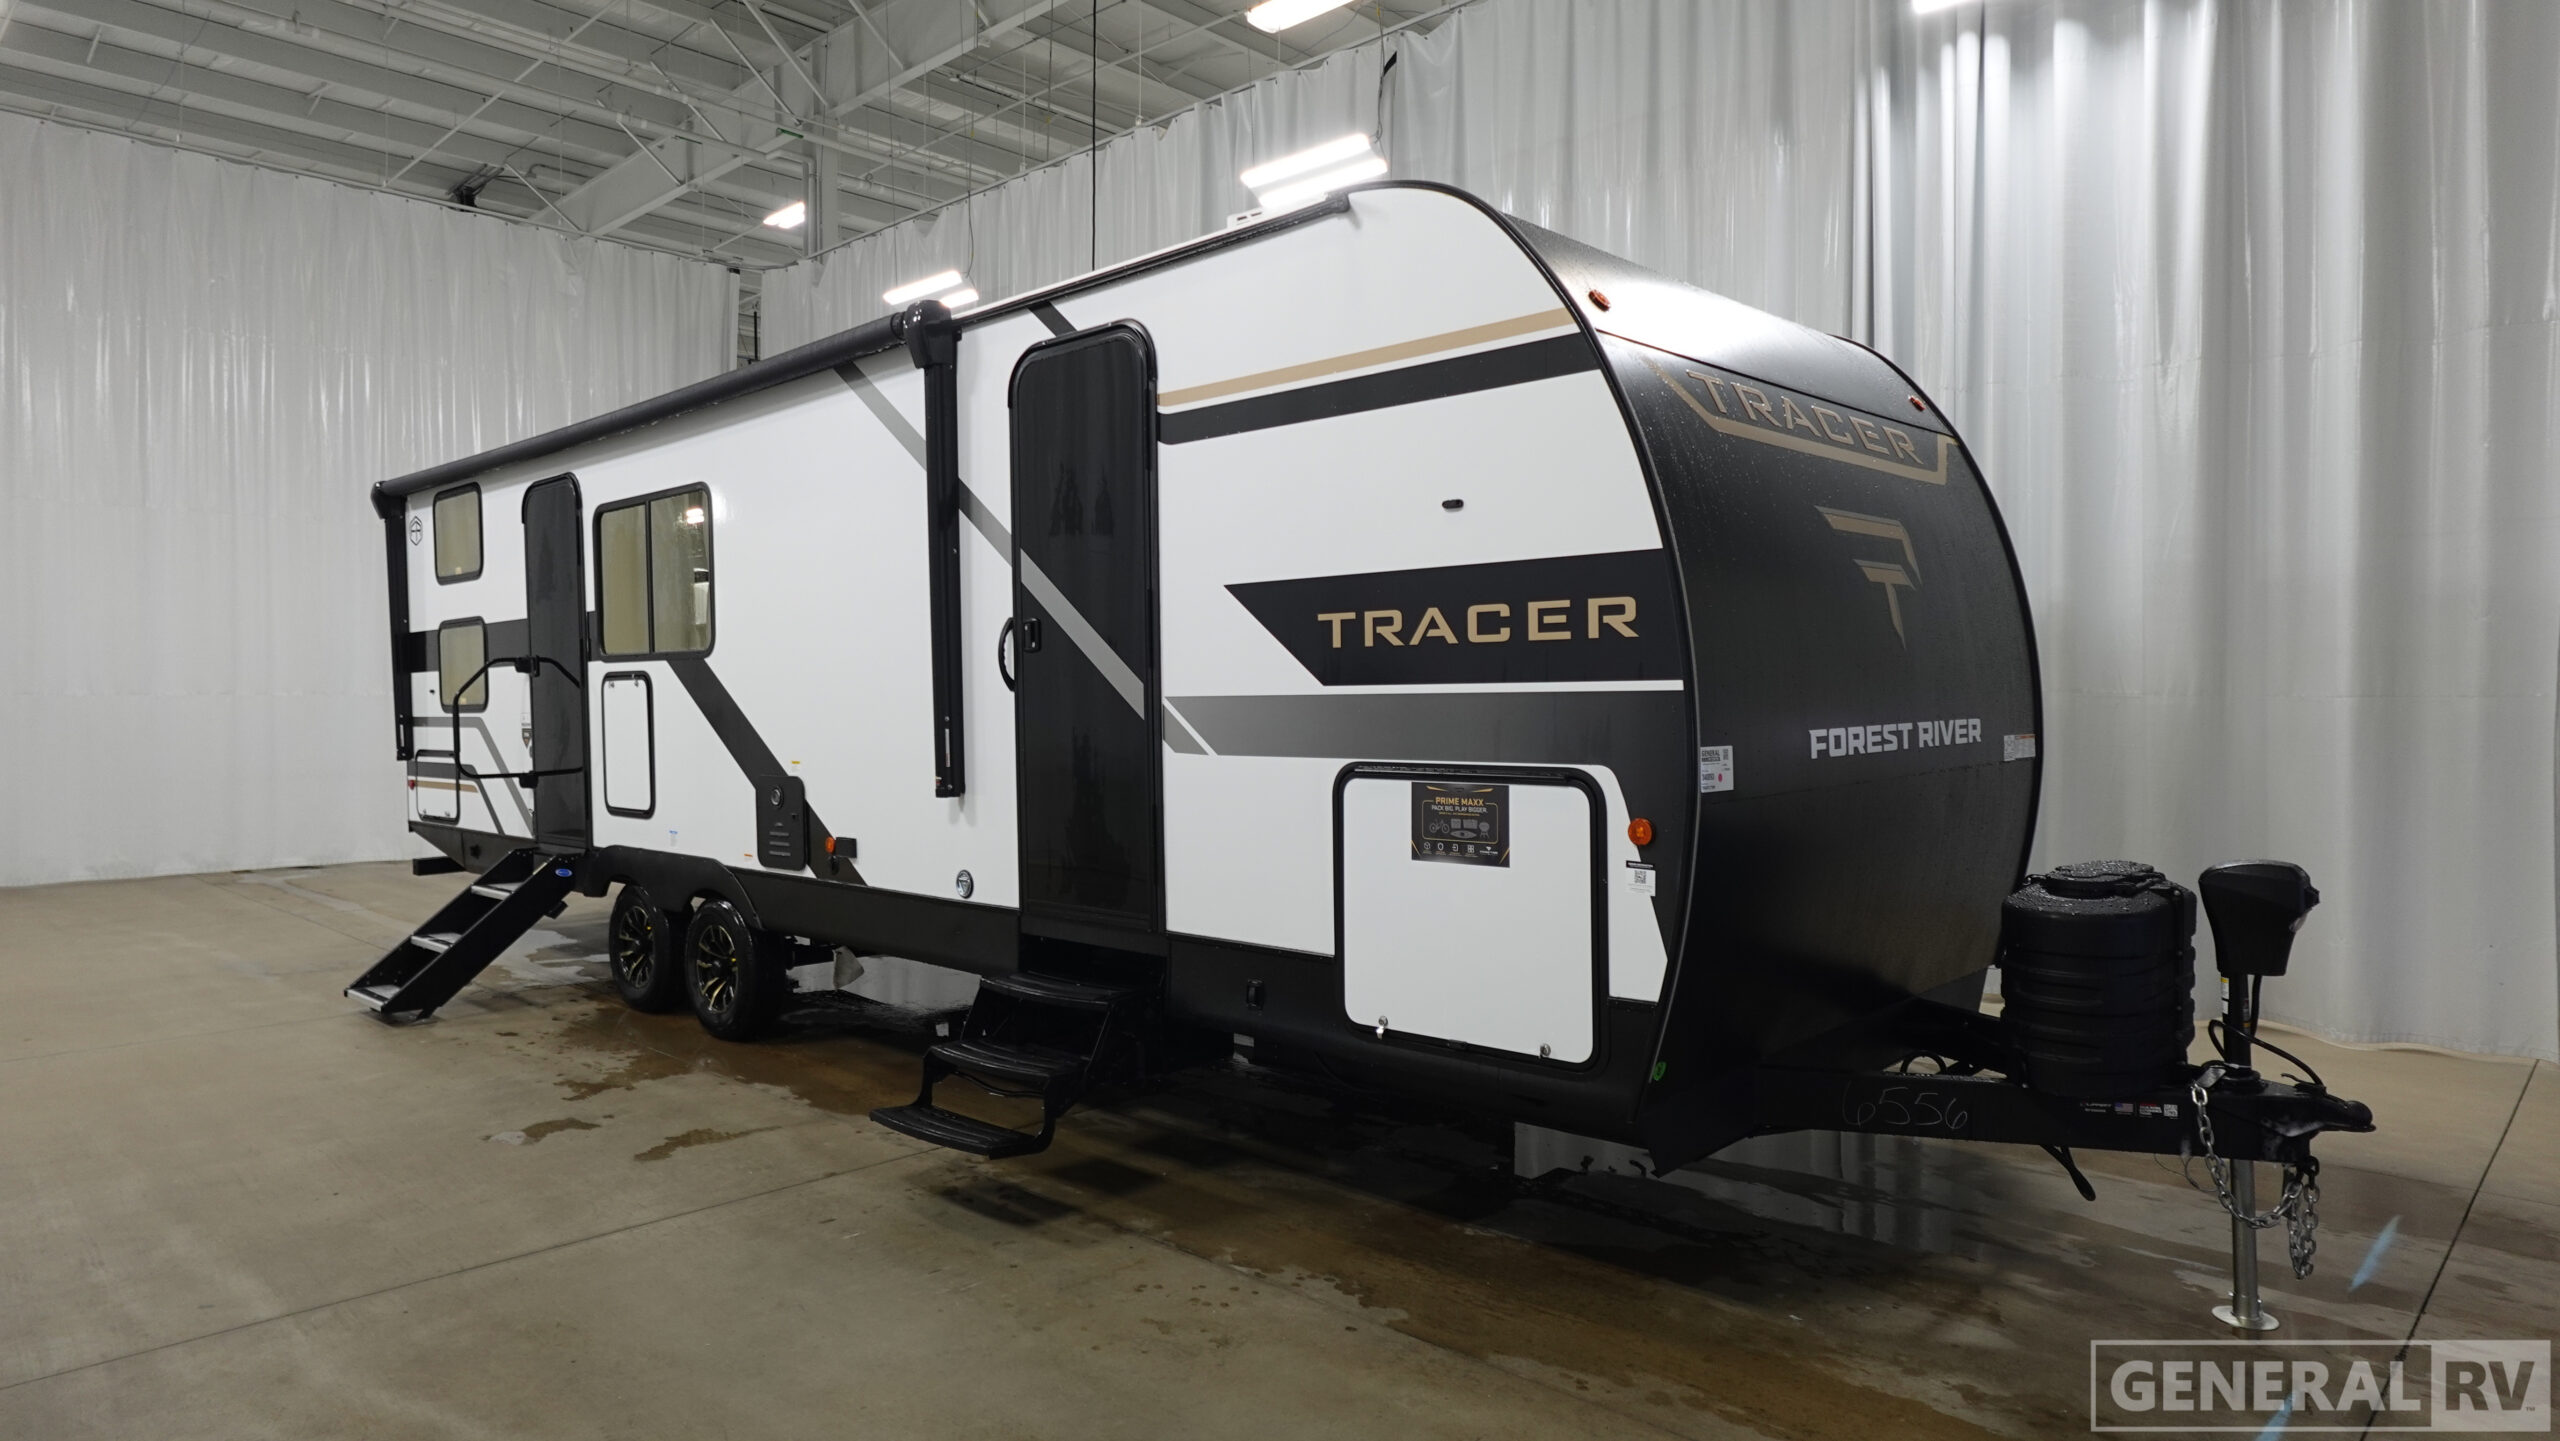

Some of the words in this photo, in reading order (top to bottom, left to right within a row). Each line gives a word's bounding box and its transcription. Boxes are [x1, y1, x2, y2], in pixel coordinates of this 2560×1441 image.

[1686, 369, 1924, 465] TRACER
[1317, 596, 1640, 649] TRACER
[1808, 722, 1914, 760] FOREST
[1917, 718, 1982, 748] RIVER
[1435, 797, 1459, 805] PRIME
[1461, 798, 1484, 806] MAXX
[1842, 1080, 1967, 1130] 6556
